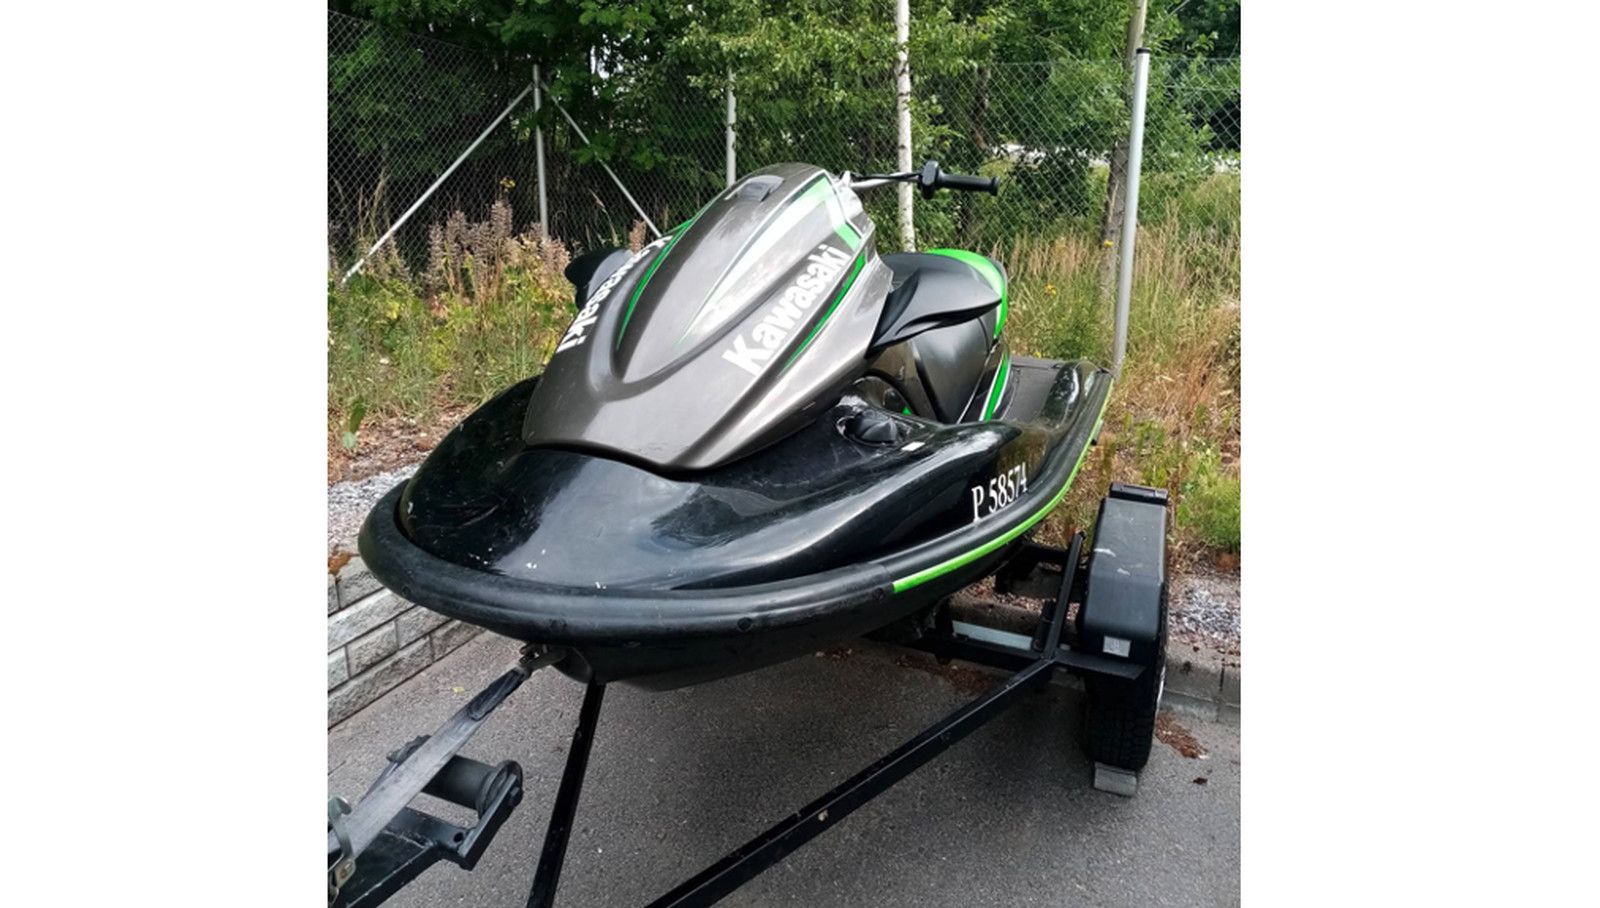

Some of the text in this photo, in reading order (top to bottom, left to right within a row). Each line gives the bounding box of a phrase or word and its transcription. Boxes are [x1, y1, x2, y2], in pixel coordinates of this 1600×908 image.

[721, 243, 851, 377] Kawasaki
[971, 461, 1028, 524] P 58574
